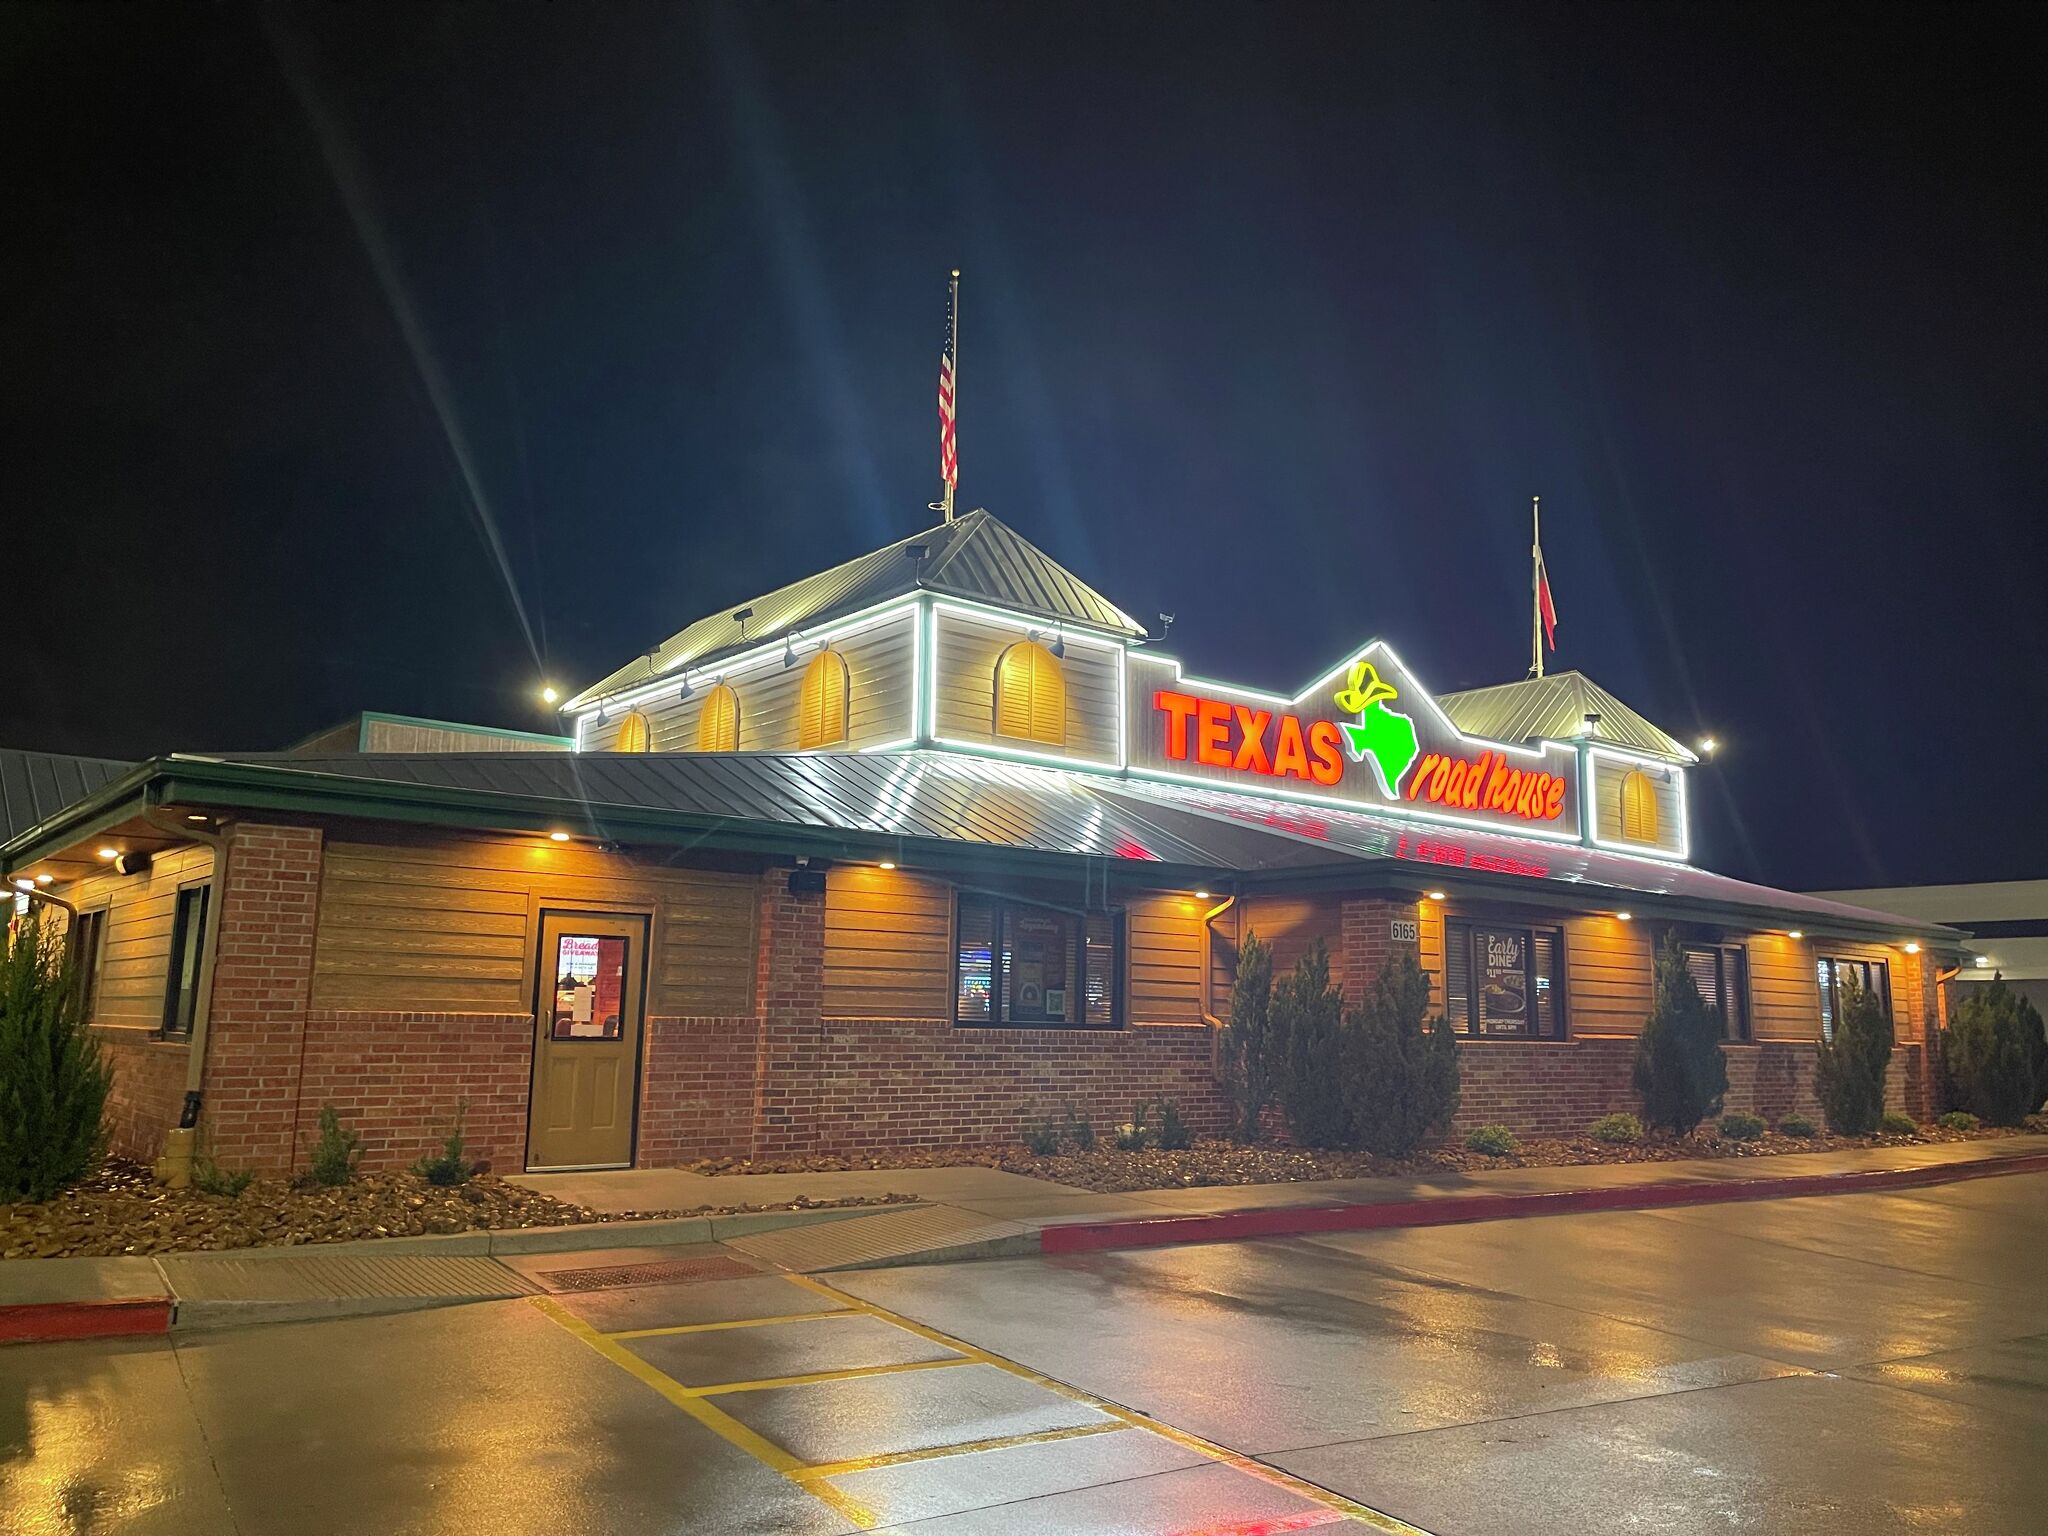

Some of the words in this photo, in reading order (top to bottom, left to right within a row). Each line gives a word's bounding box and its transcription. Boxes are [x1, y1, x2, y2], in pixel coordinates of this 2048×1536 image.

[1153, 691, 1343, 786] TEXAS
[1393, 923, 1415, 939] 6165
[1488, 935, 1520, 963] Early
[1488, 953, 1513, 968] DINE
